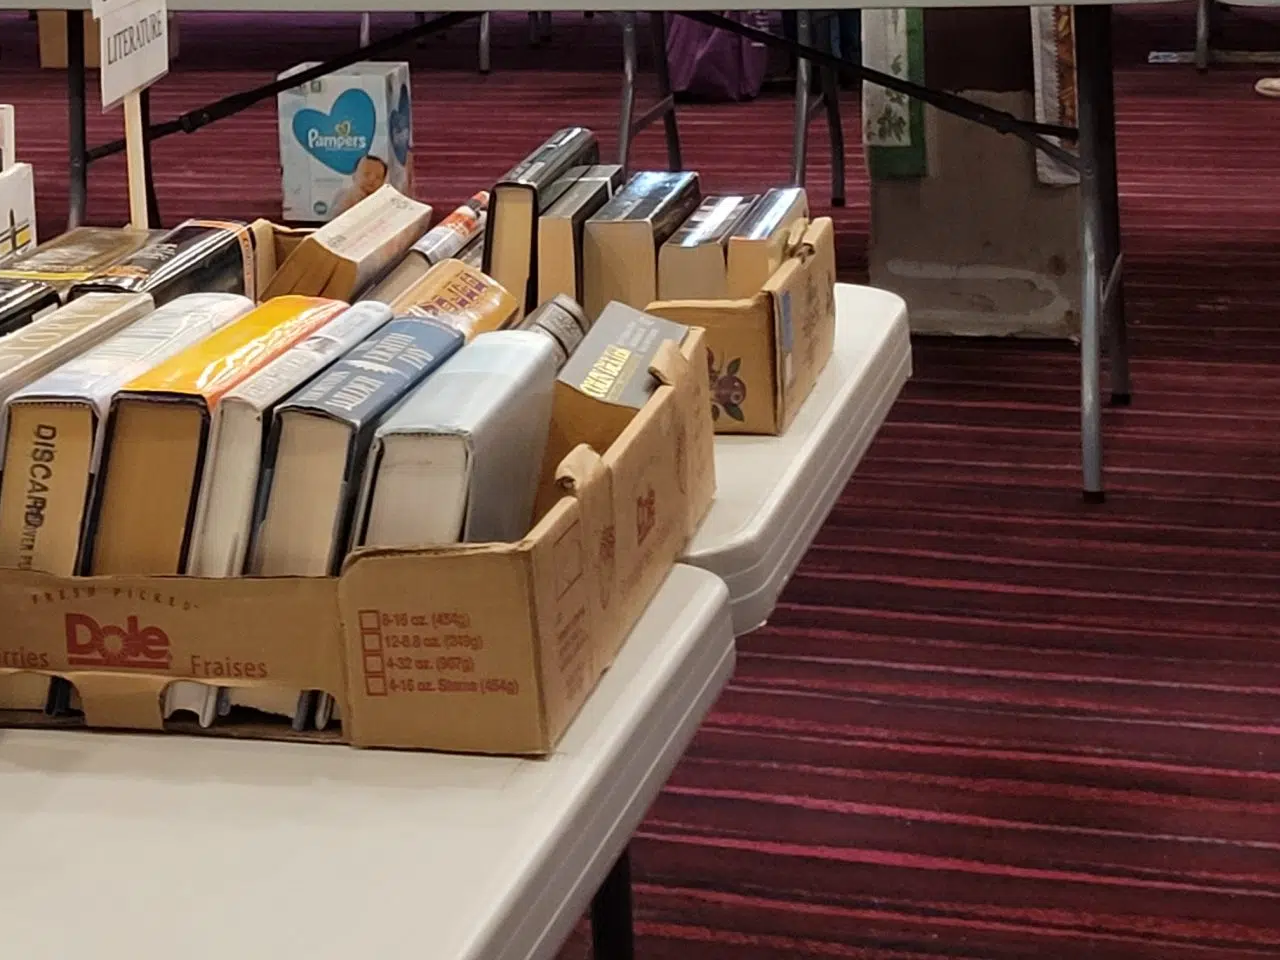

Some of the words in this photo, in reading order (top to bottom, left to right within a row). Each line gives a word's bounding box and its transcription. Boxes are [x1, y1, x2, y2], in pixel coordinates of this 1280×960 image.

[107, 11, 163, 66] LITERATURE
[308, 128, 367, 150] Pampers
[24, 423, 57, 530] DISCARD
[65, 612, 170, 666] Dole
[190, 655, 268, 678] Fraises
